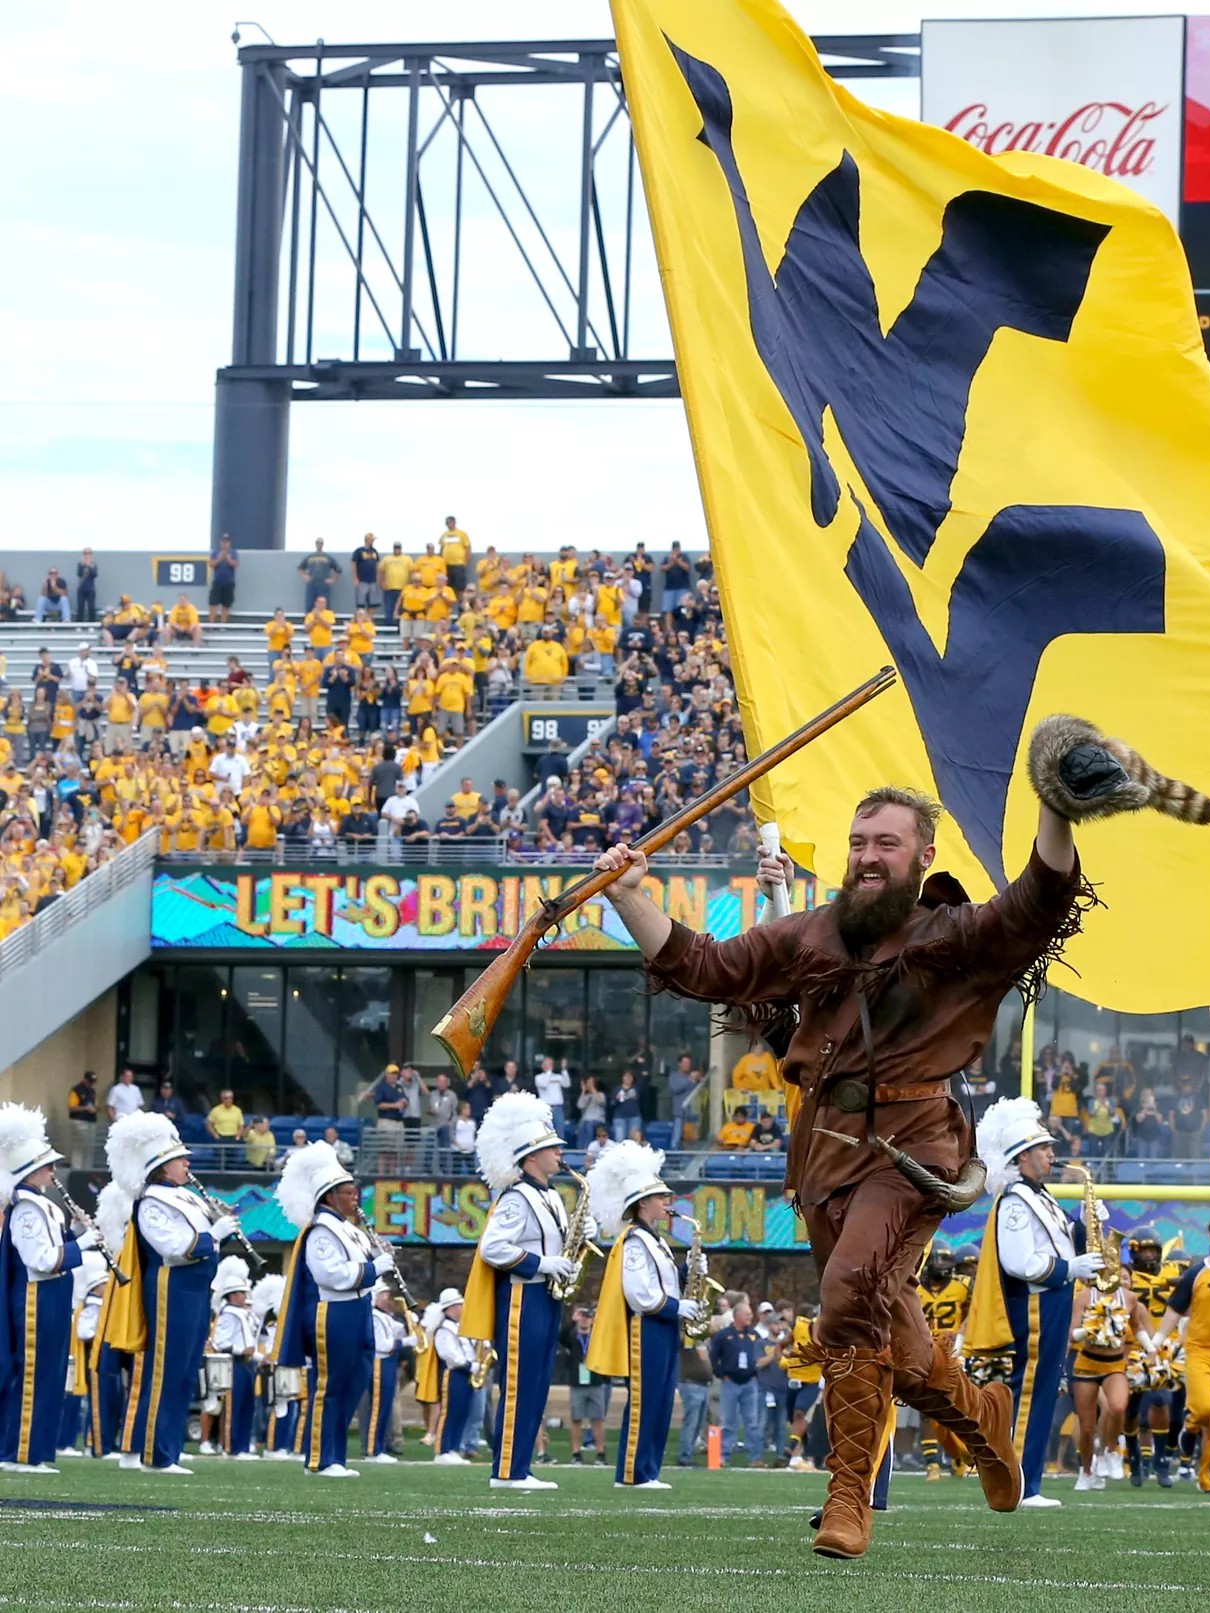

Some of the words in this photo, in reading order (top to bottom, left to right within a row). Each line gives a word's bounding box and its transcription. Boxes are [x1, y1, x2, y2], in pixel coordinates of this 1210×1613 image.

[169, 562, 195, 582] 98
[531, 719, 558, 740] 98
[235, 872, 401, 939] LET'S
[350, 1179, 491, 1240] ET'S
[692, 1185, 767, 1243] ON
